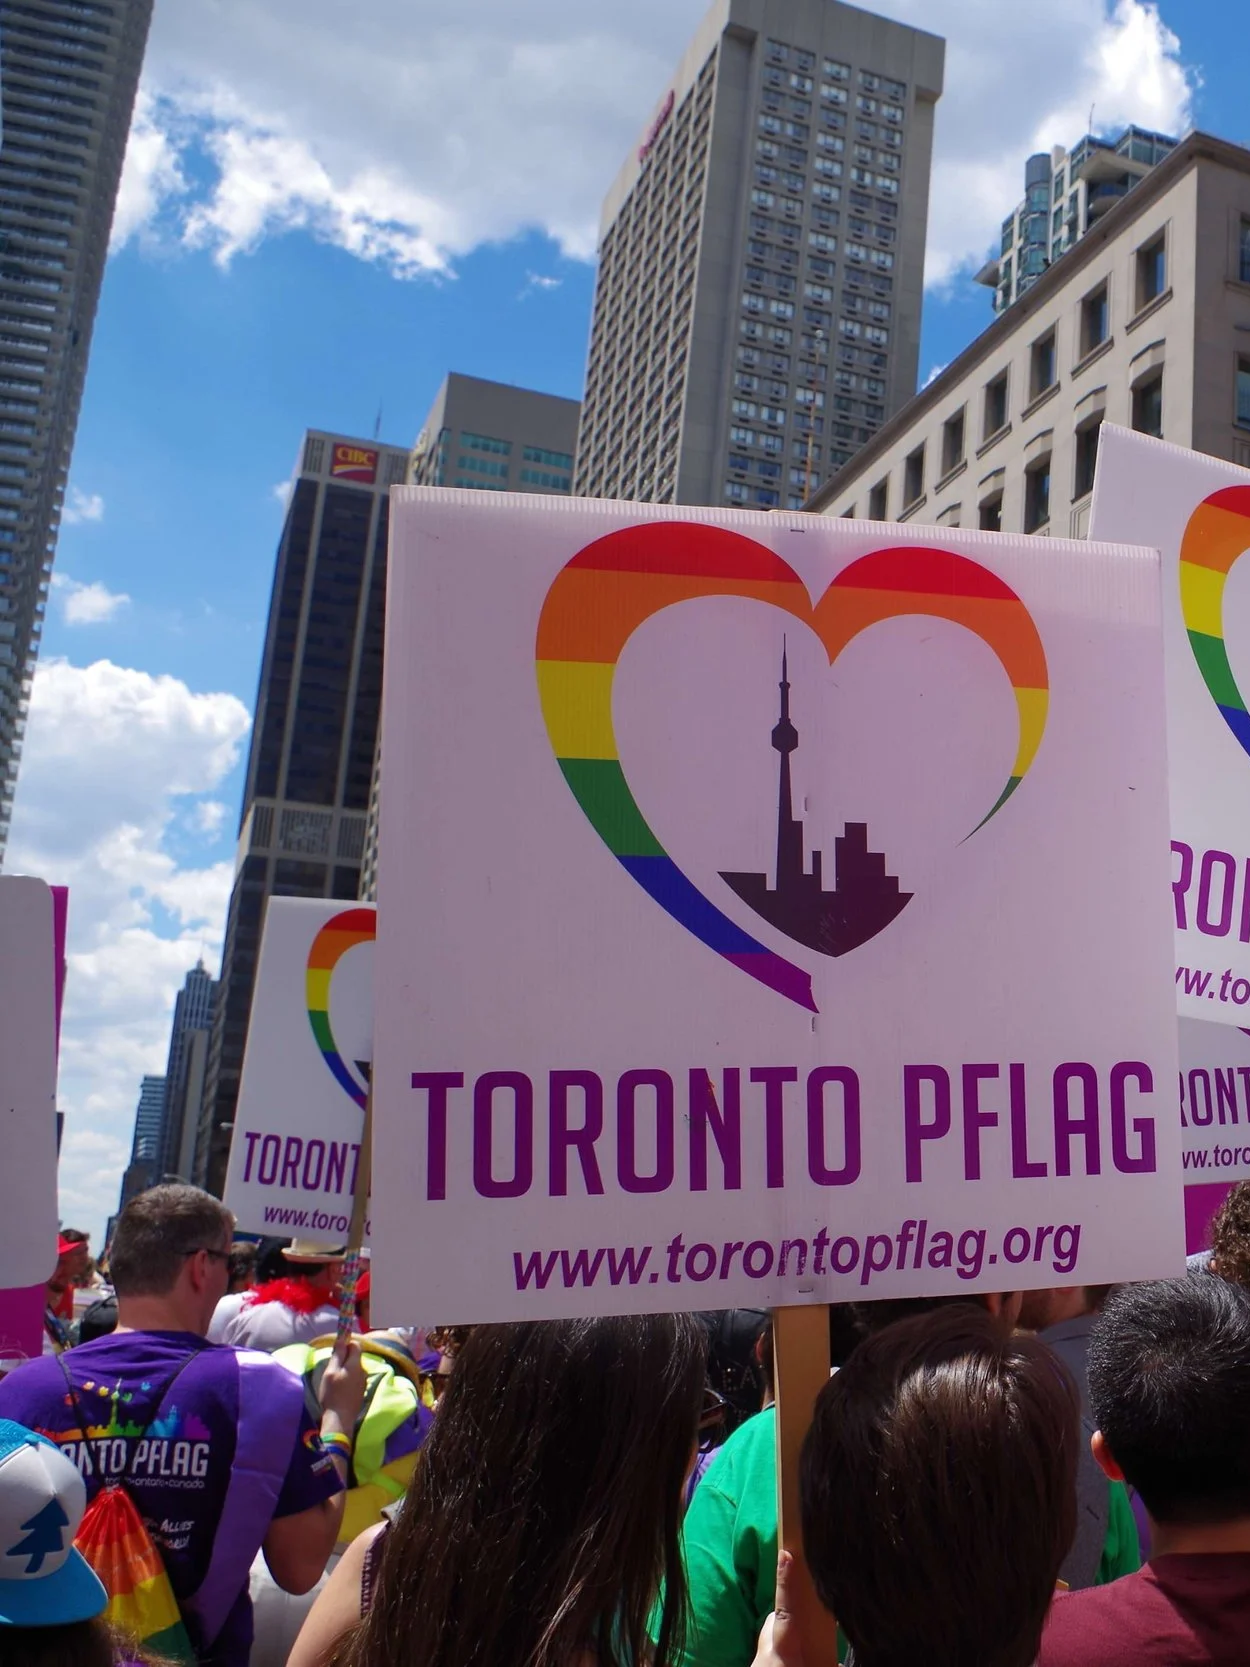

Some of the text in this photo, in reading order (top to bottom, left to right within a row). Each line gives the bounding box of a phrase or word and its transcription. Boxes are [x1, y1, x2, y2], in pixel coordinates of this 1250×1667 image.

[337, 447, 375, 465] CIBC
[243, 1131, 362, 1197] TORONT
[411, 1061, 1158, 1201] TORONTO PFLAG
[512, 1219, 1082, 1292] www.torontopflag.org
[131, 1440, 210, 1478] PFLAG
